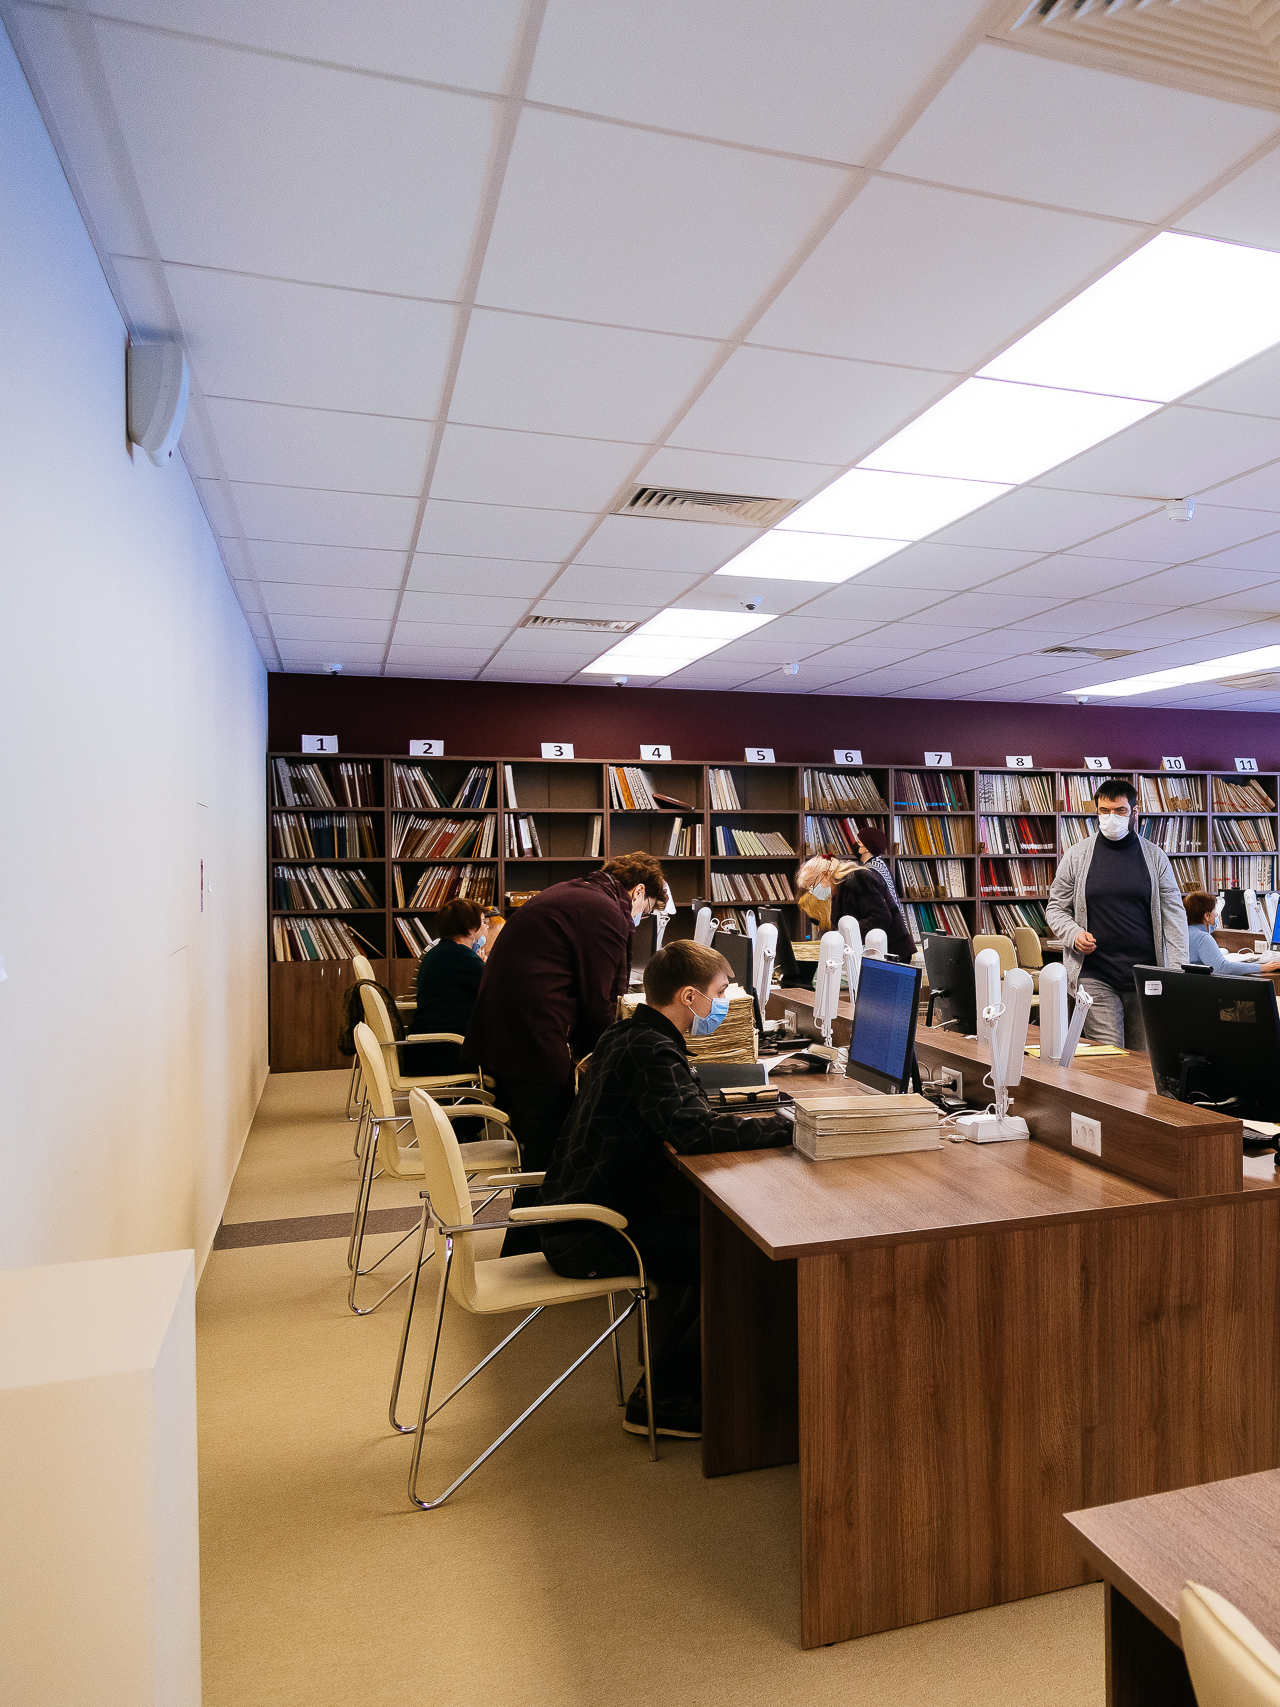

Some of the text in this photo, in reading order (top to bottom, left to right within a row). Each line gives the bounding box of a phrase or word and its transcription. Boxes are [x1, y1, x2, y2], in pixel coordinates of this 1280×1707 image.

[316, 738, 327, 751] 1
[422, 742, 434, 755] 2
[553, 745, 564, 757] 3
[651, 747, 662, 759] 4
[756, 750, 766, 761] 5
[844, 752, 854, 763] 6
[934, 754, 943, 765] 7
[1016, 757, 1025, 767] 8
[1094, 758, 1103, 768] 9
[1166, 759, 1182, 770] 10
[1239, 760, 1255, 770] 11
